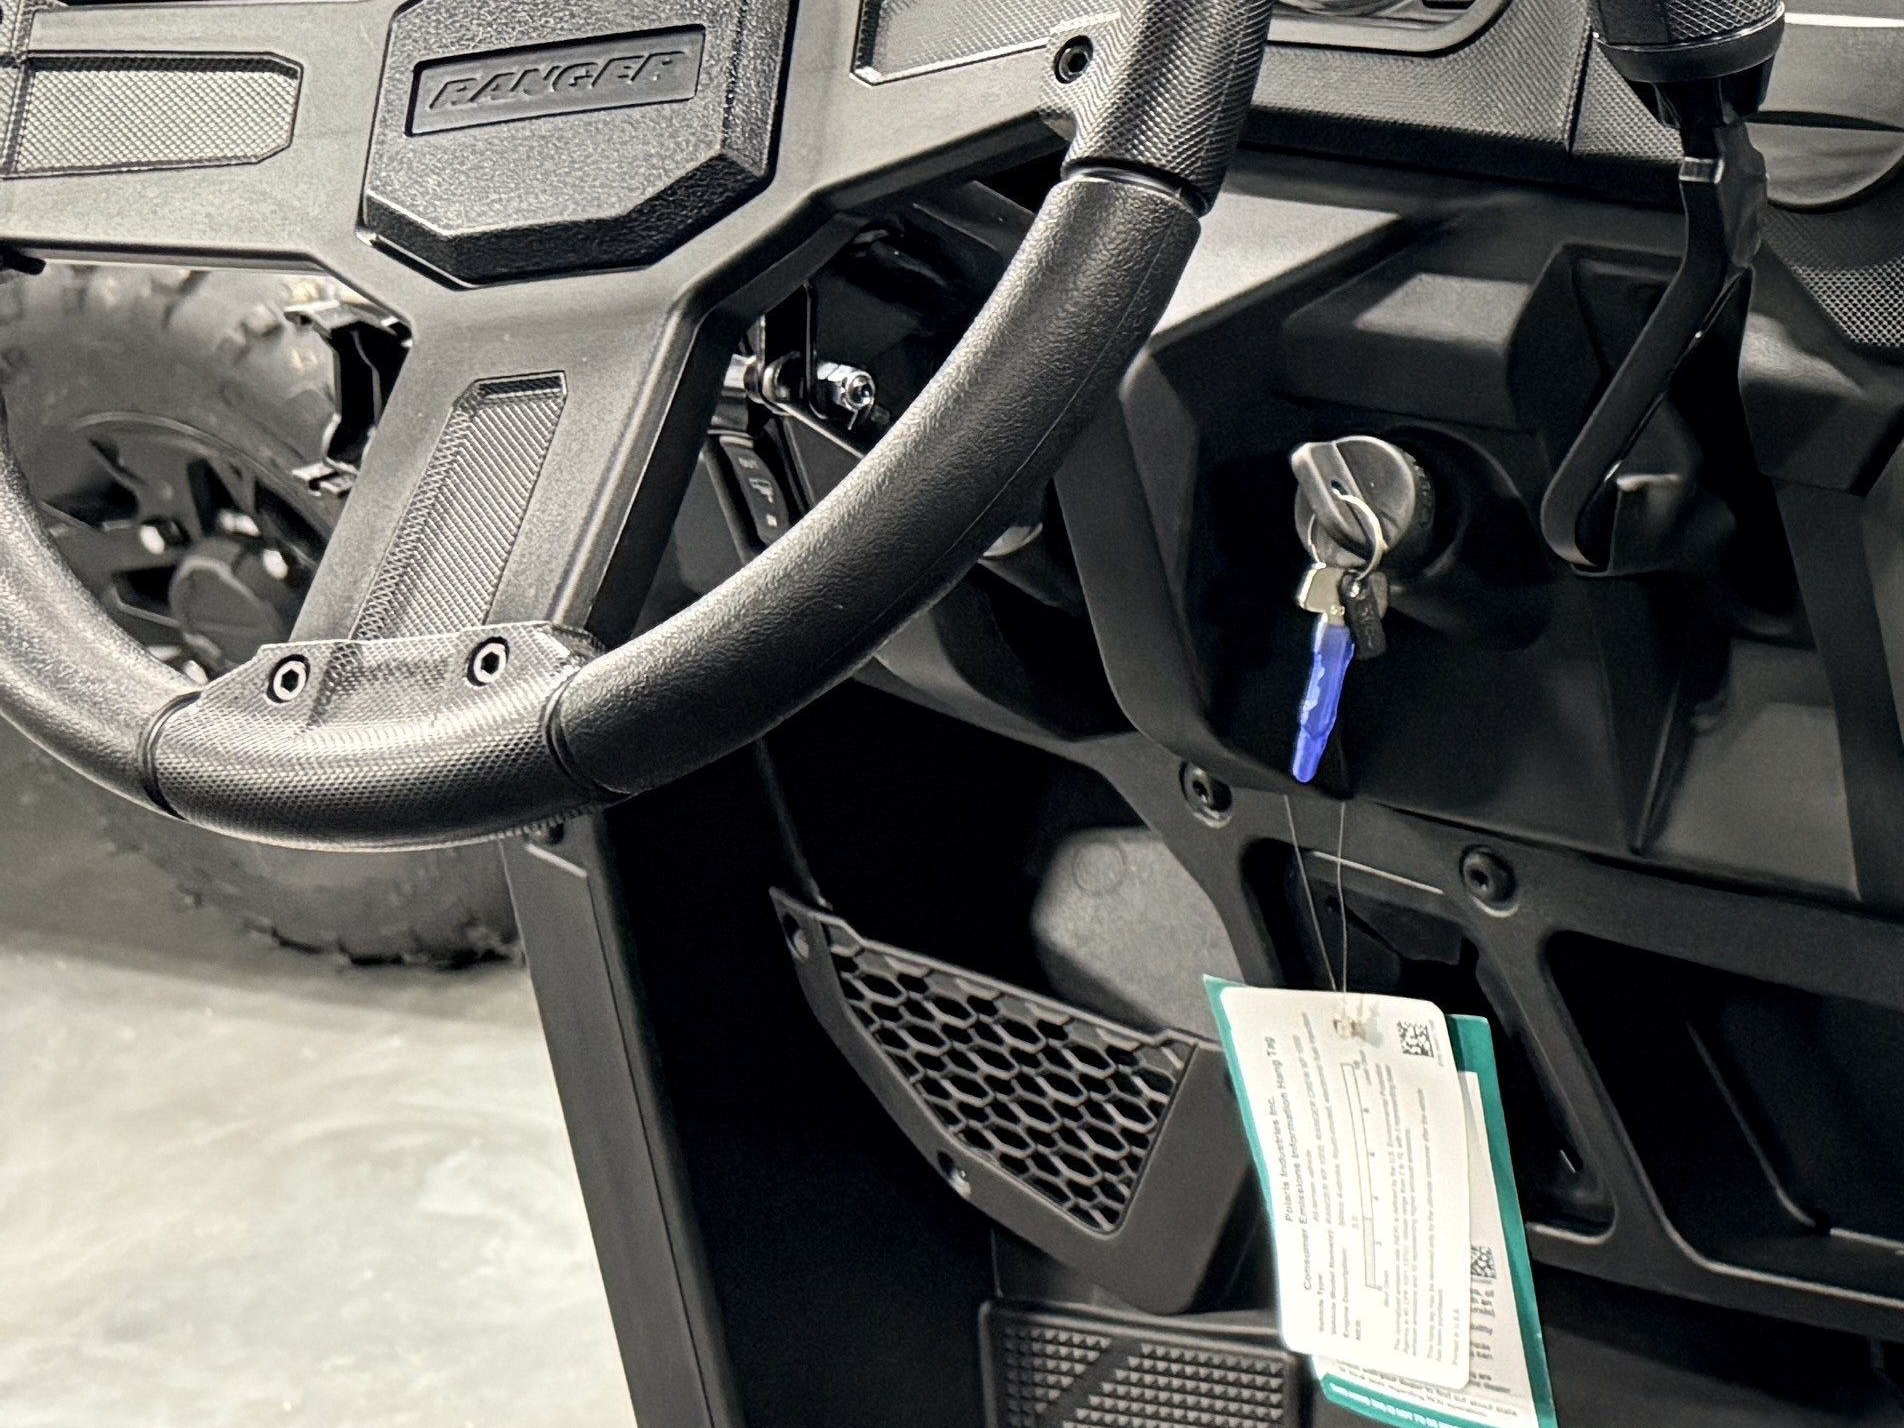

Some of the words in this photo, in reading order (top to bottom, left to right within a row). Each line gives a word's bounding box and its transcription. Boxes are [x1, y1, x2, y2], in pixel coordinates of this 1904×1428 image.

[428, 49, 689, 112] RANGER
[1264, 1036, 1277, 1055] Tag
[1270, 1059, 1287, 1088] Hang
[1265, 1095, 1278, 1115] Inc.
[1277, 1092, 1300, 1158] Information
[1270, 1118, 1288, 1176] Industries
[1280, 1181, 1295, 1222] Polaris
[1291, 1162, 1308, 1224] Emissions
[1299, 1227, 1312, 1290] Consumer
